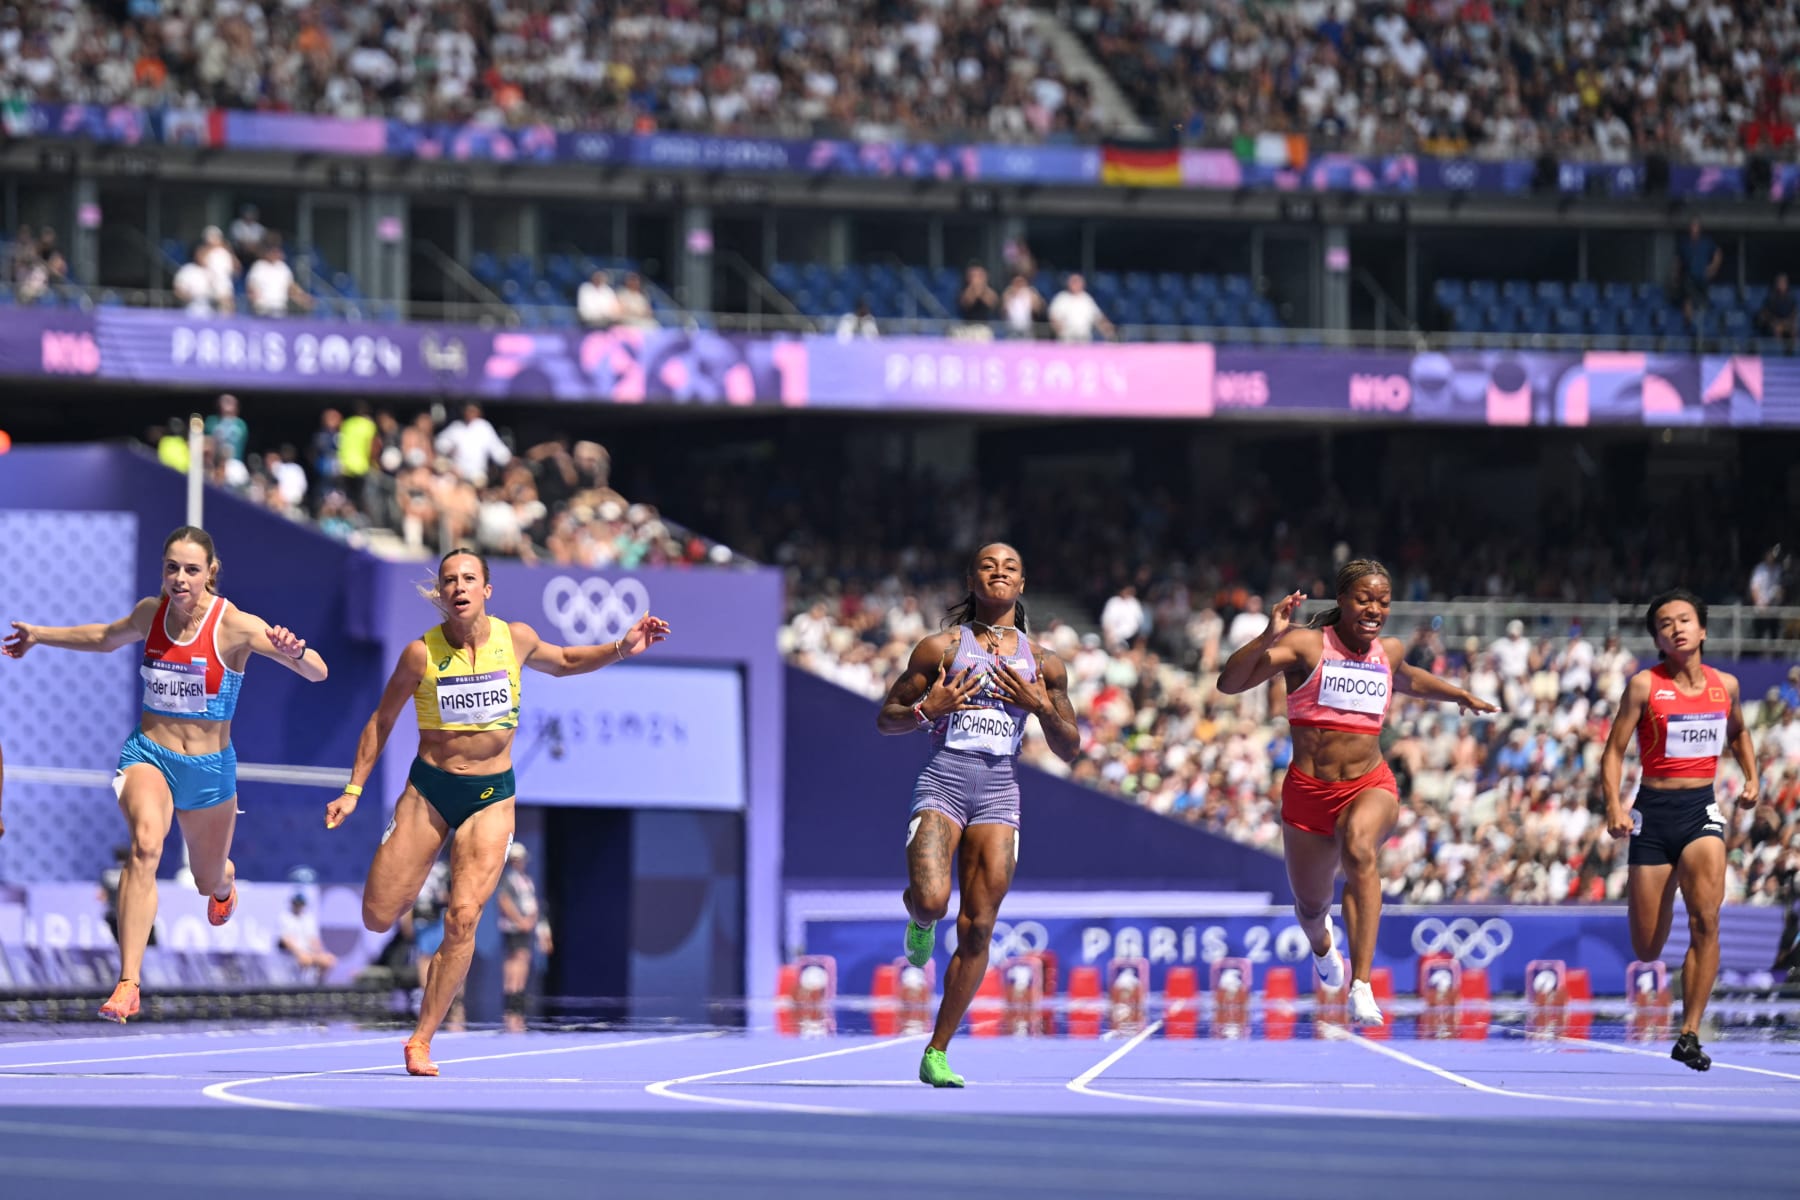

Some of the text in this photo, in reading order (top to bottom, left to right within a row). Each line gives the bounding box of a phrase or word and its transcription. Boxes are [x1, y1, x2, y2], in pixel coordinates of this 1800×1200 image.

[294, 333, 401, 377] 2024
[1018, 358, 1129, 398] 2024
[152, 678, 168, 695] der
[170, 680, 204, 697] WEKEN
[1323, 675, 1387, 697] MADOGO
[441, 688, 508, 710] MASTERS
[1680, 728, 1718, 743] TRAN
